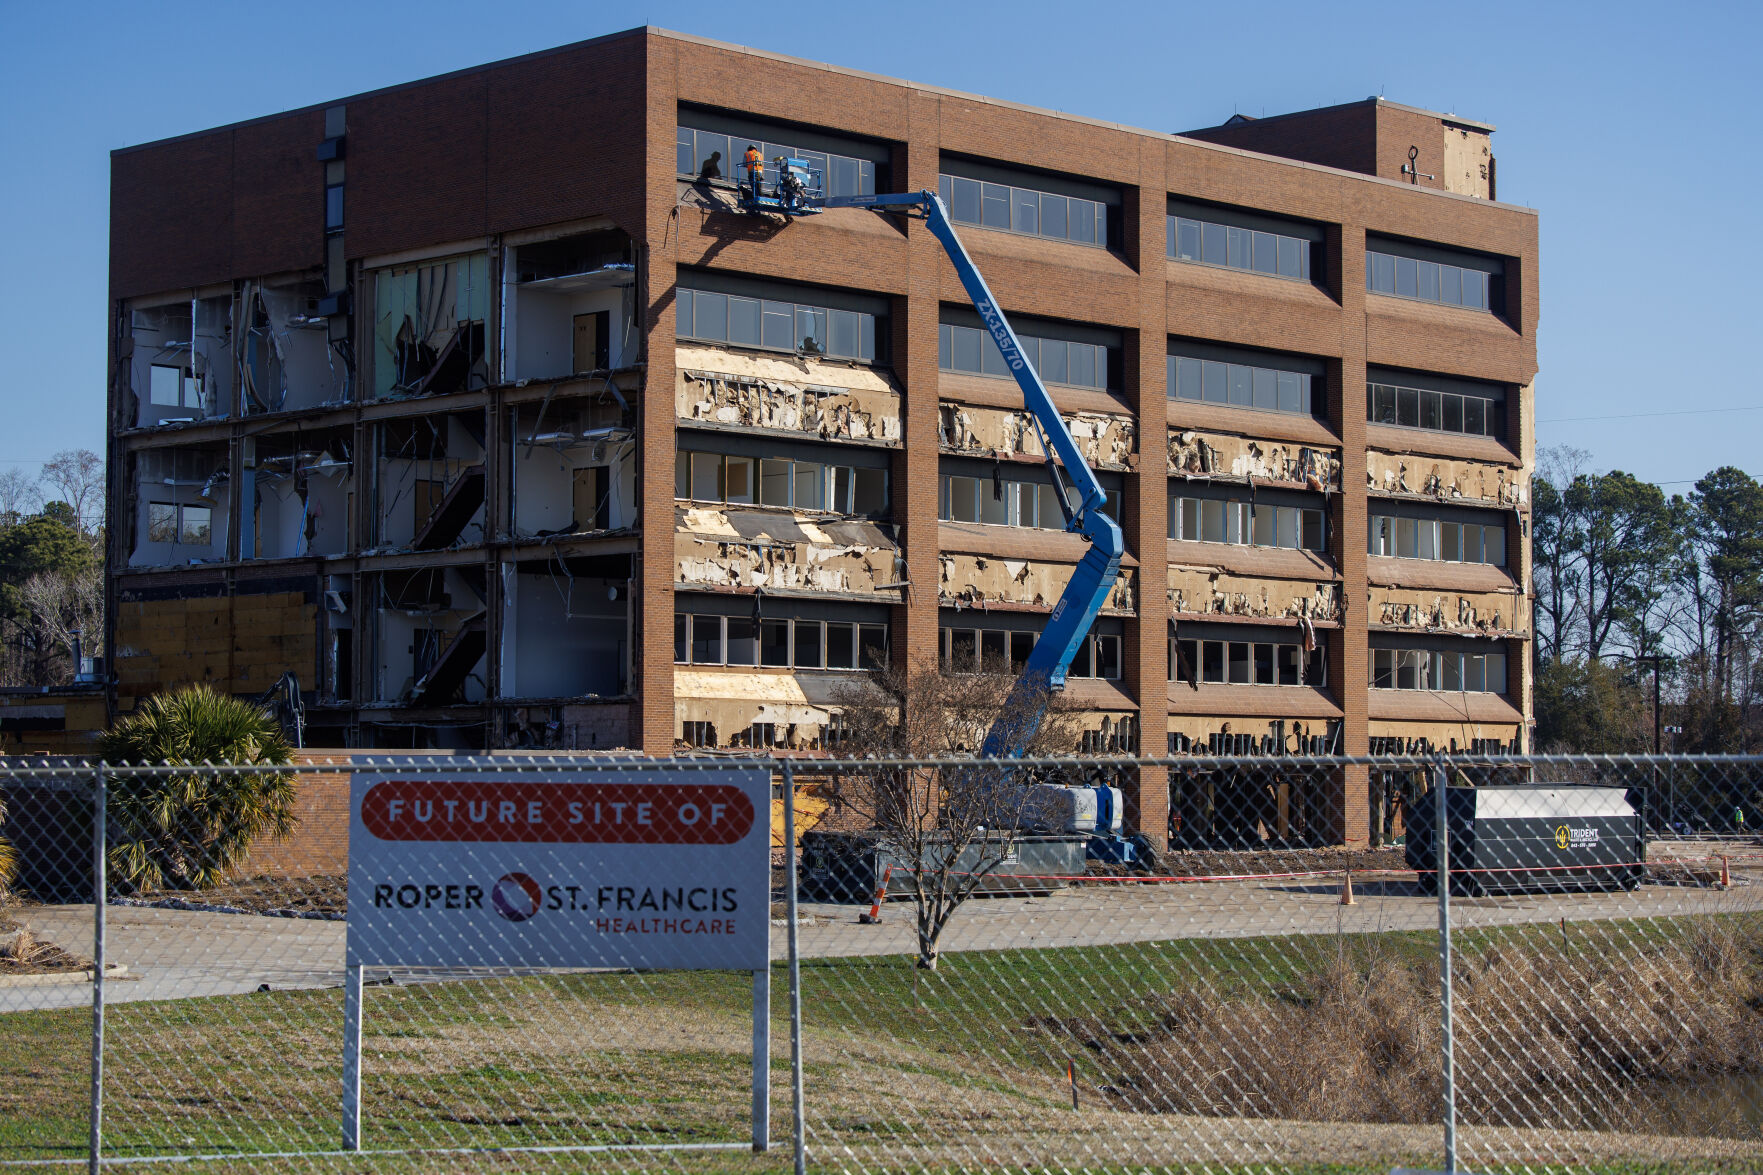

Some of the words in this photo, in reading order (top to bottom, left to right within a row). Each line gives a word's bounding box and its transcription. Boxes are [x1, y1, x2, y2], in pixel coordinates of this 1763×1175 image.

[977, 298, 1024, 370] ZX-135/70
[389, 800, 543, 823] FUTURE
[568, 801, 653, 825] SITE
[678, 803, 727, 825] OF
[1570, 828, 1599, 838] TRIDENT
[375, 884, 484, 909] ROPER
[547, 886, 589, 911] ST.
[597, 887, 738, 912] FRANCIS
[596, 918, 737, 935] HEALTHCARE
